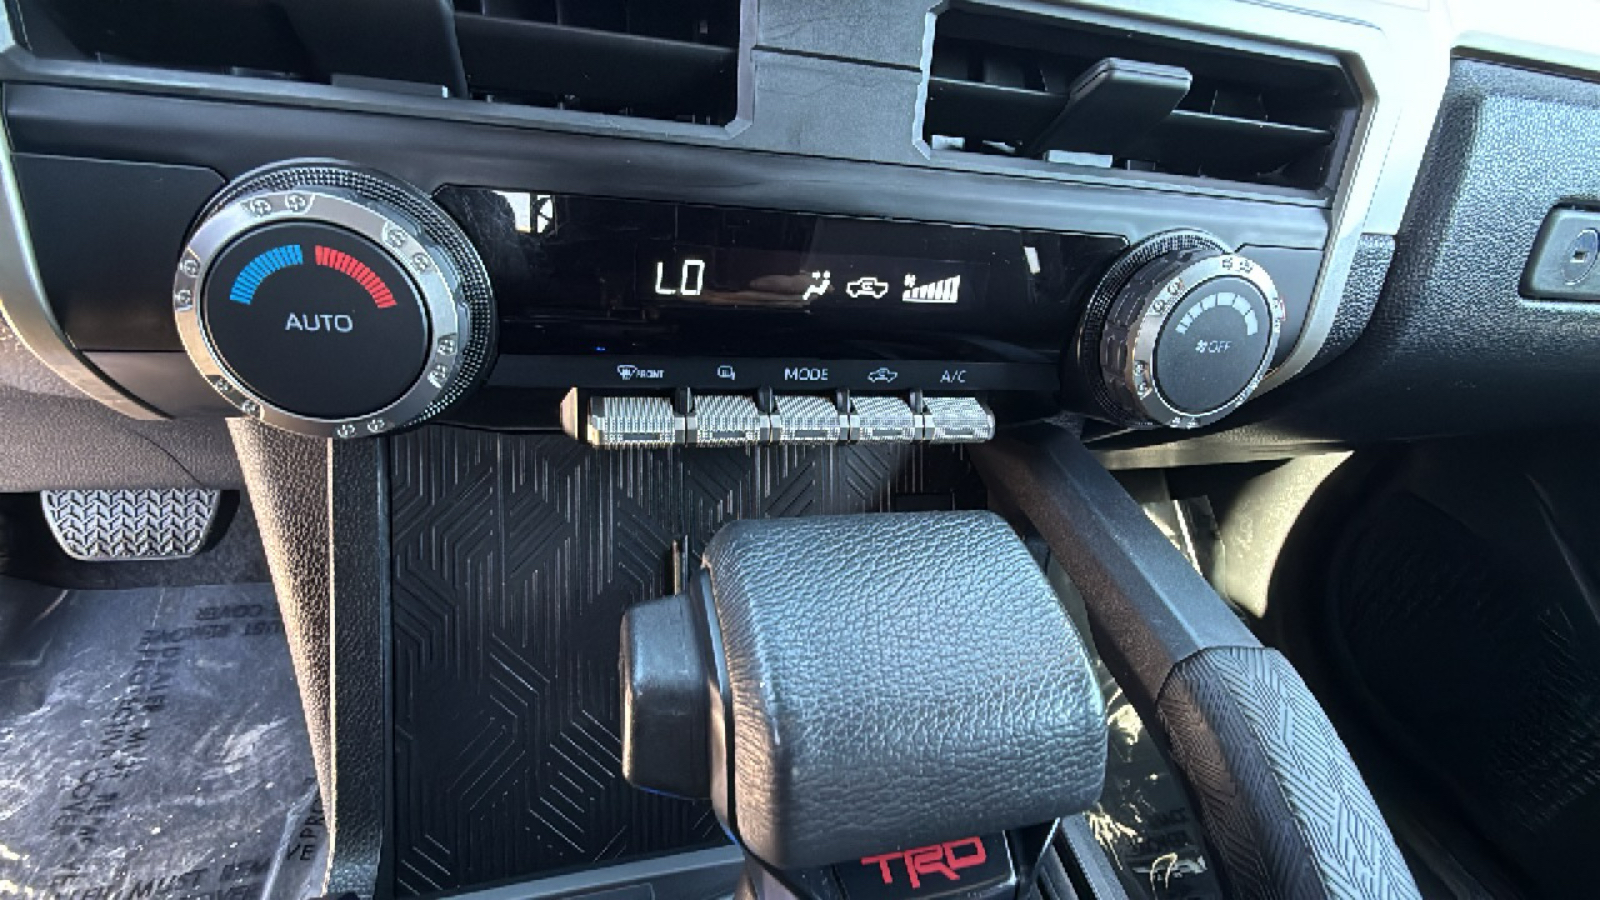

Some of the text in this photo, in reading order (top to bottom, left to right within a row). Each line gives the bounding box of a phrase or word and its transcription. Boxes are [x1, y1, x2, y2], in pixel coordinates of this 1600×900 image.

[655, 259, 705, 296] LO
[284, 311, 354, 334] AUTO
[1208, 340, 1233, 354] OFF
[636, 369, 665, 379] FRONT
[784, 367, 829, 381] MODE
[939, 369, 967, 384] A/C
[860, 836, 987, 889] TRD
